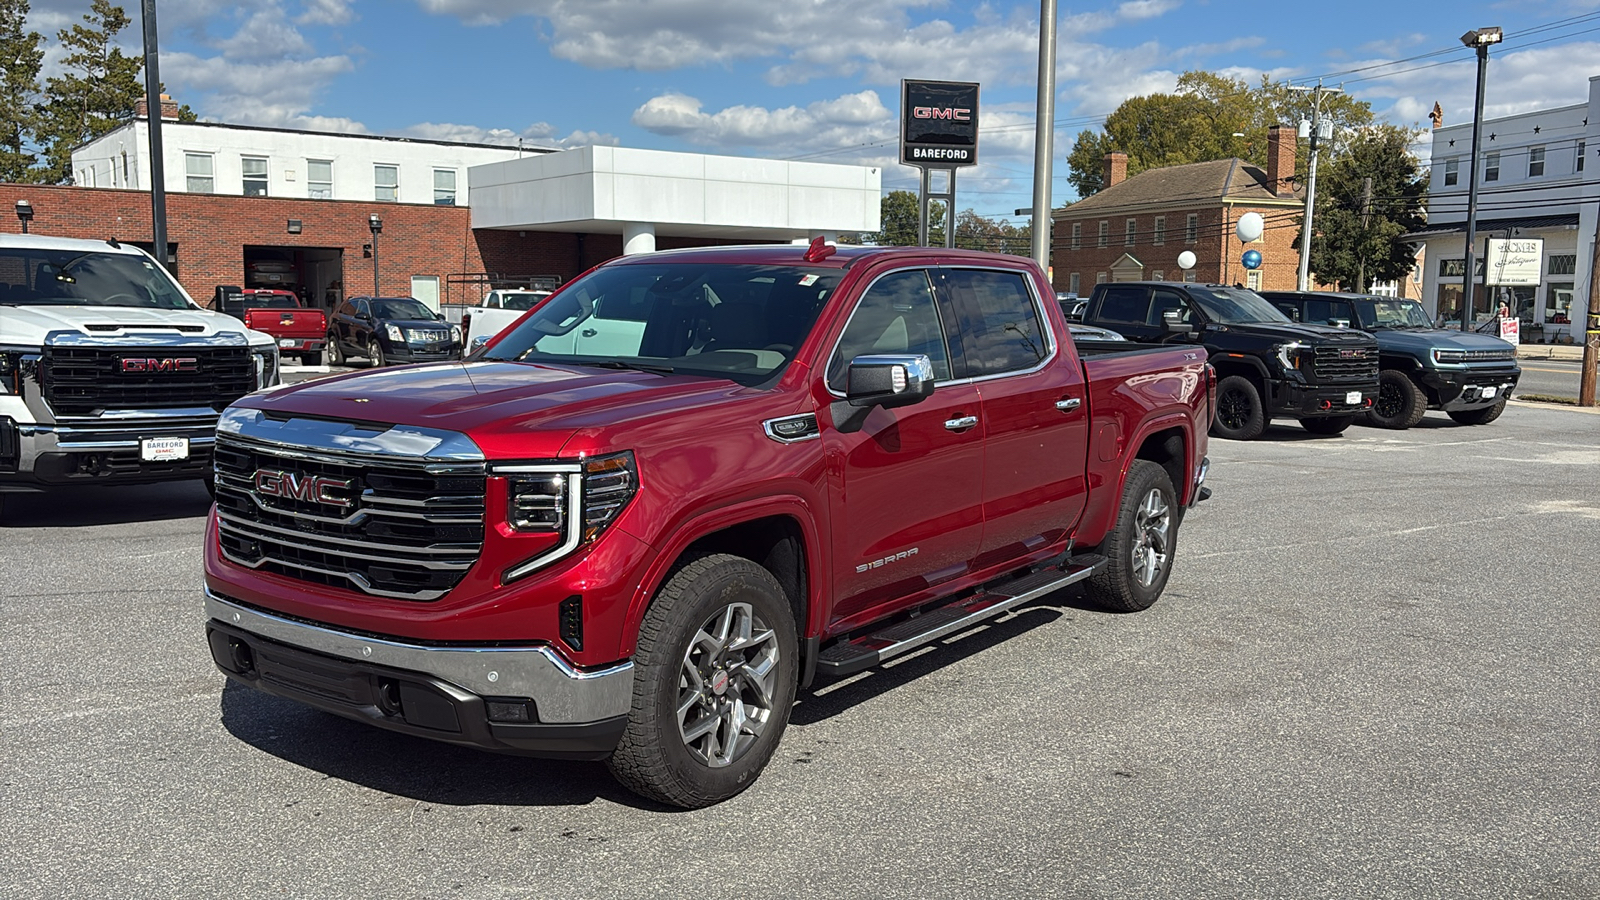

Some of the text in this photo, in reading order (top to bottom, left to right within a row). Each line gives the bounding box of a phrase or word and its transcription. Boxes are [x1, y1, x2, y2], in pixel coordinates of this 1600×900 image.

[914, 106, 971, 120] GMC
[913, 148, 968, 159] BAREFORD
[122, 358, 198, 371] GMC
[147, 441, 184, 449] BAREFORD
[255, 469, 351, 507] GMC
[855, 547, 919, 573] SIERRA
